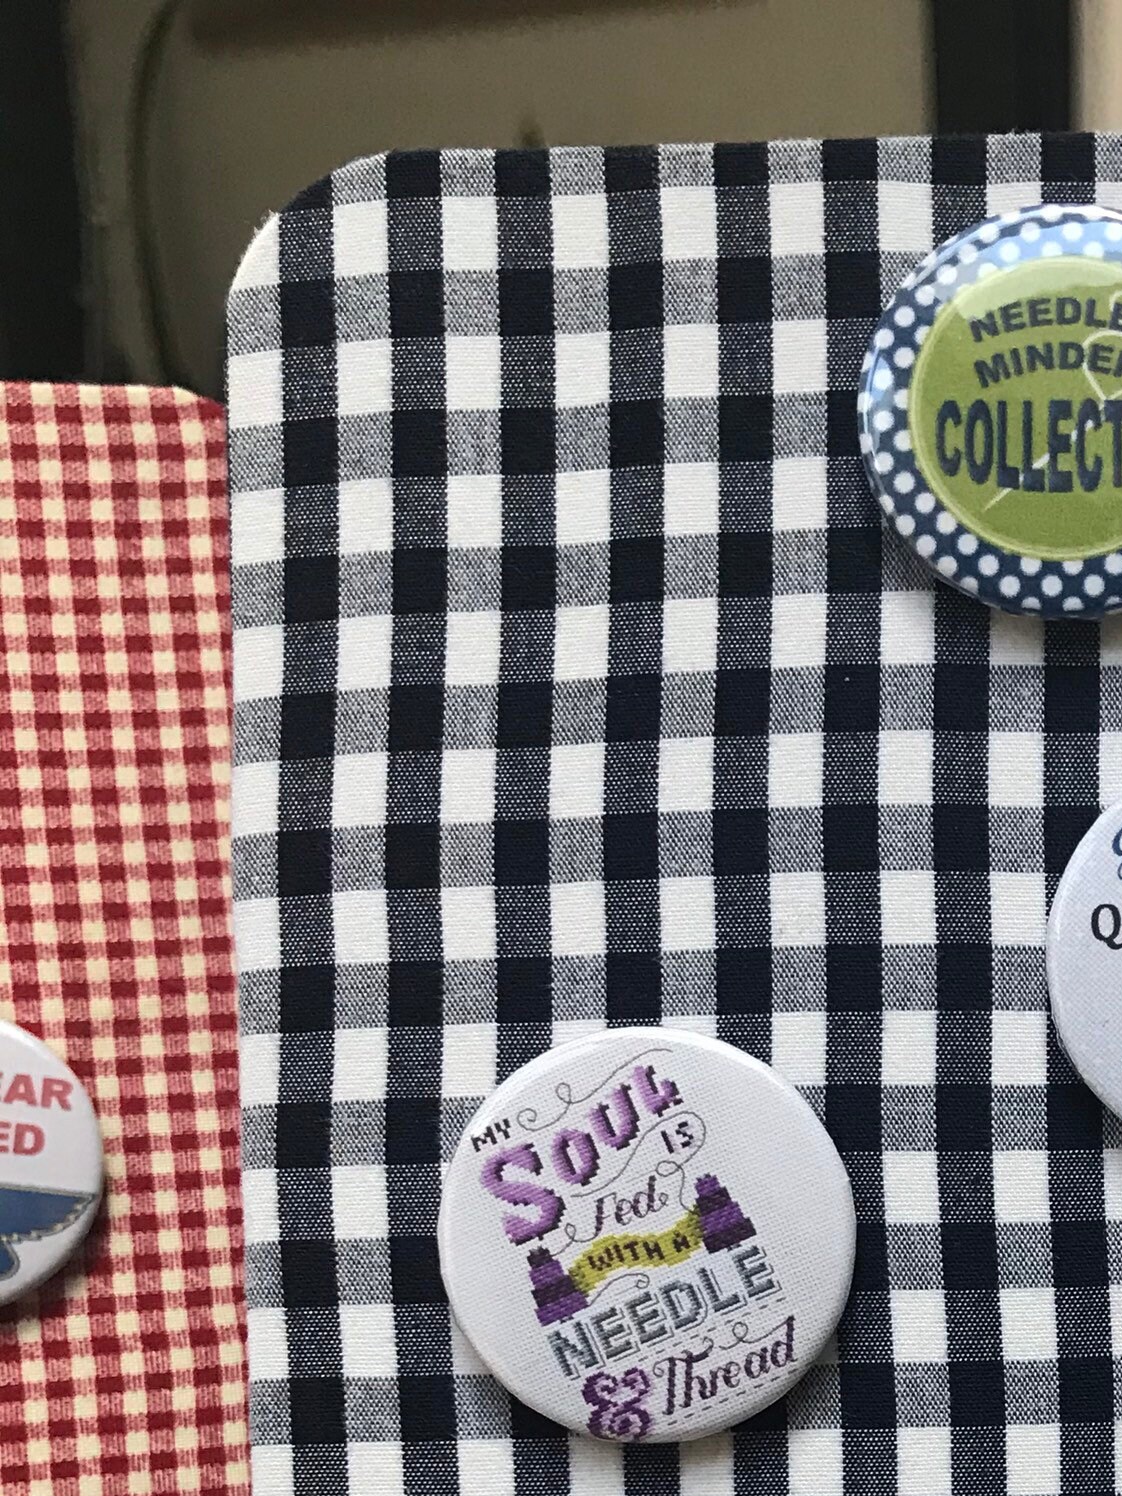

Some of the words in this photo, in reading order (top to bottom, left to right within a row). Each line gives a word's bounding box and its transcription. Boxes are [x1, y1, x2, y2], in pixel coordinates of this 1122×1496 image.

[0, 1072, 73, 1111] AR
[470, 1118, 514, 1153] MY
[479, 1064, 684, 1246] SOUL
[660, 1120, 694, 1154] IS
[587, 1241, 665, 1271] WITH
[672, 1231, 691, 1253] A
[546, 1243, 782, 1380] NEEDLE
[653, 1315, 798, 1415] Thread
